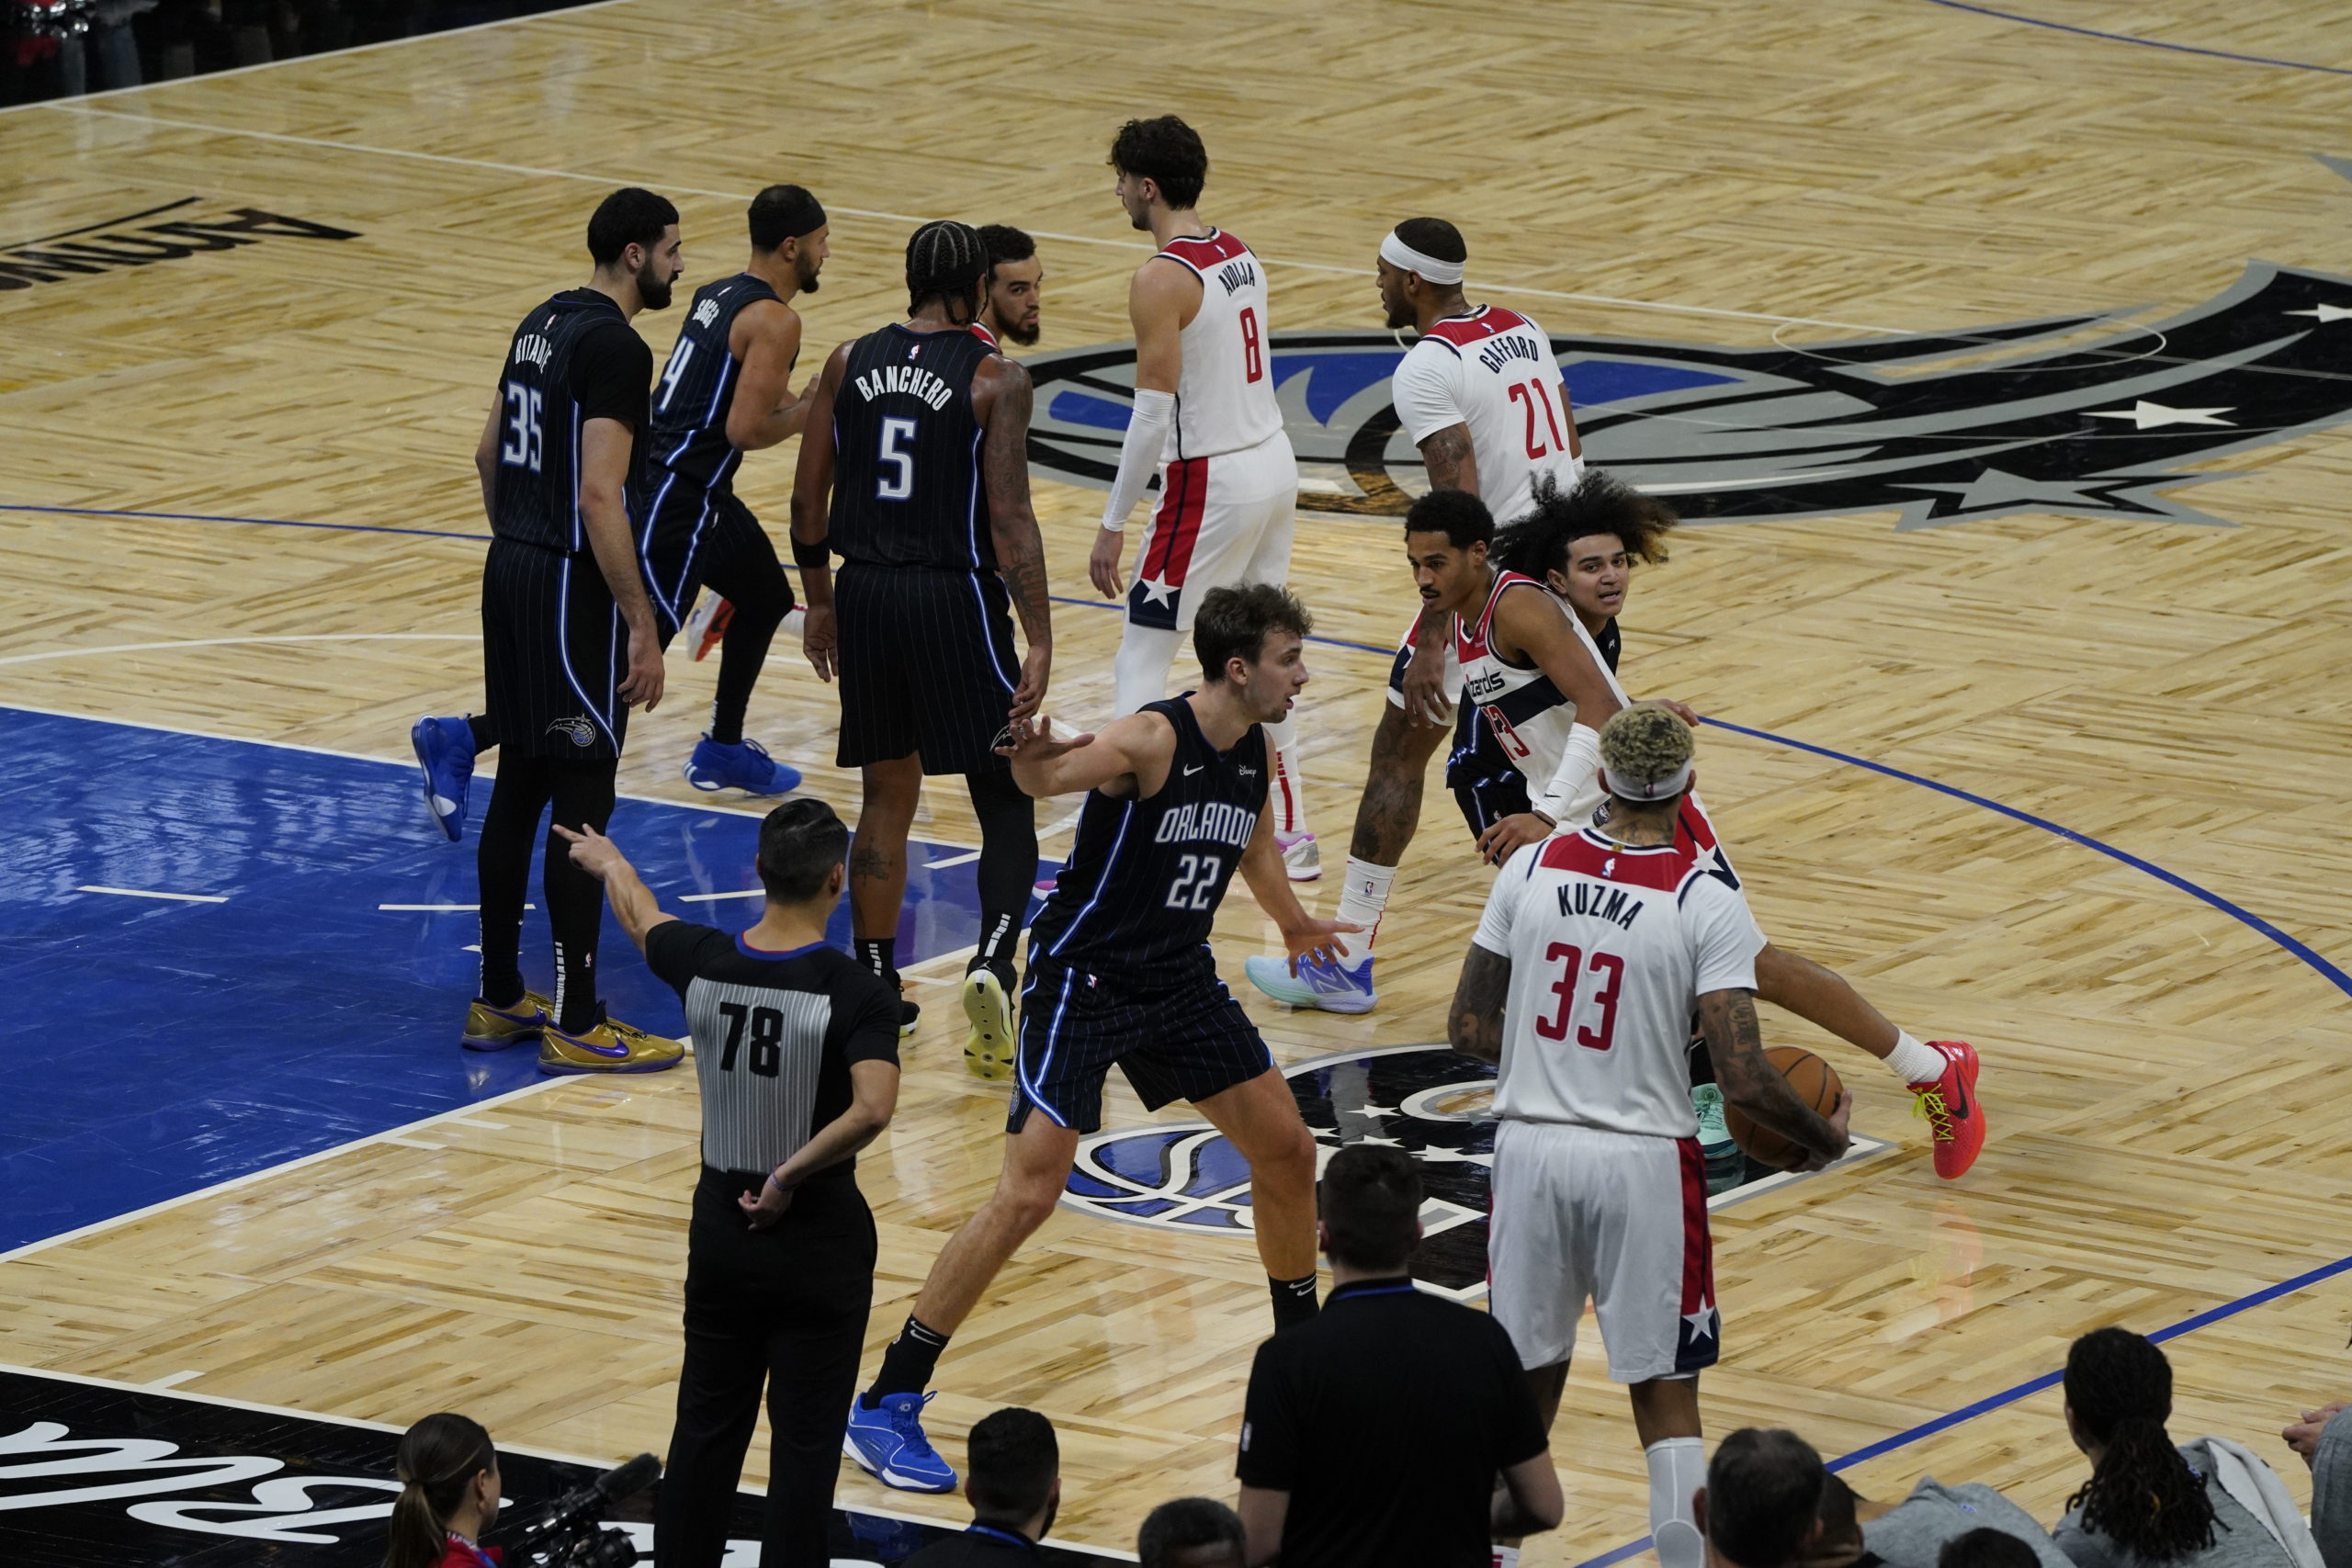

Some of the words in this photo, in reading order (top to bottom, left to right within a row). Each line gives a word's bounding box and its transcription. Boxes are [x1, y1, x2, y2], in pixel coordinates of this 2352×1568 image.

[0, 208, 363, 290] Amw
[1217, 262, 1256, 297] AVDIJA
[658, 334, 696, 412] 4
[1239, 306, 1263, 385] 8
[1479, 335, 1539, 375] GAFFORD
[502, 379, 543, 474] 35
[855, 366, 953, 412] BANCHERO
[1508, 378, 1566, 460] 21
[876, 415, 918, 501] 5
[1464, 666, 1506, 698] izards
[1154, 802, 1258, 851] ORLANDO
[1165, 854, 1222, 910] 22
[1557, 883, 1644, 931] KUZMA
[1535, 941, 1625, 1052] 33
[718, 1001, 784, 1077] 78
